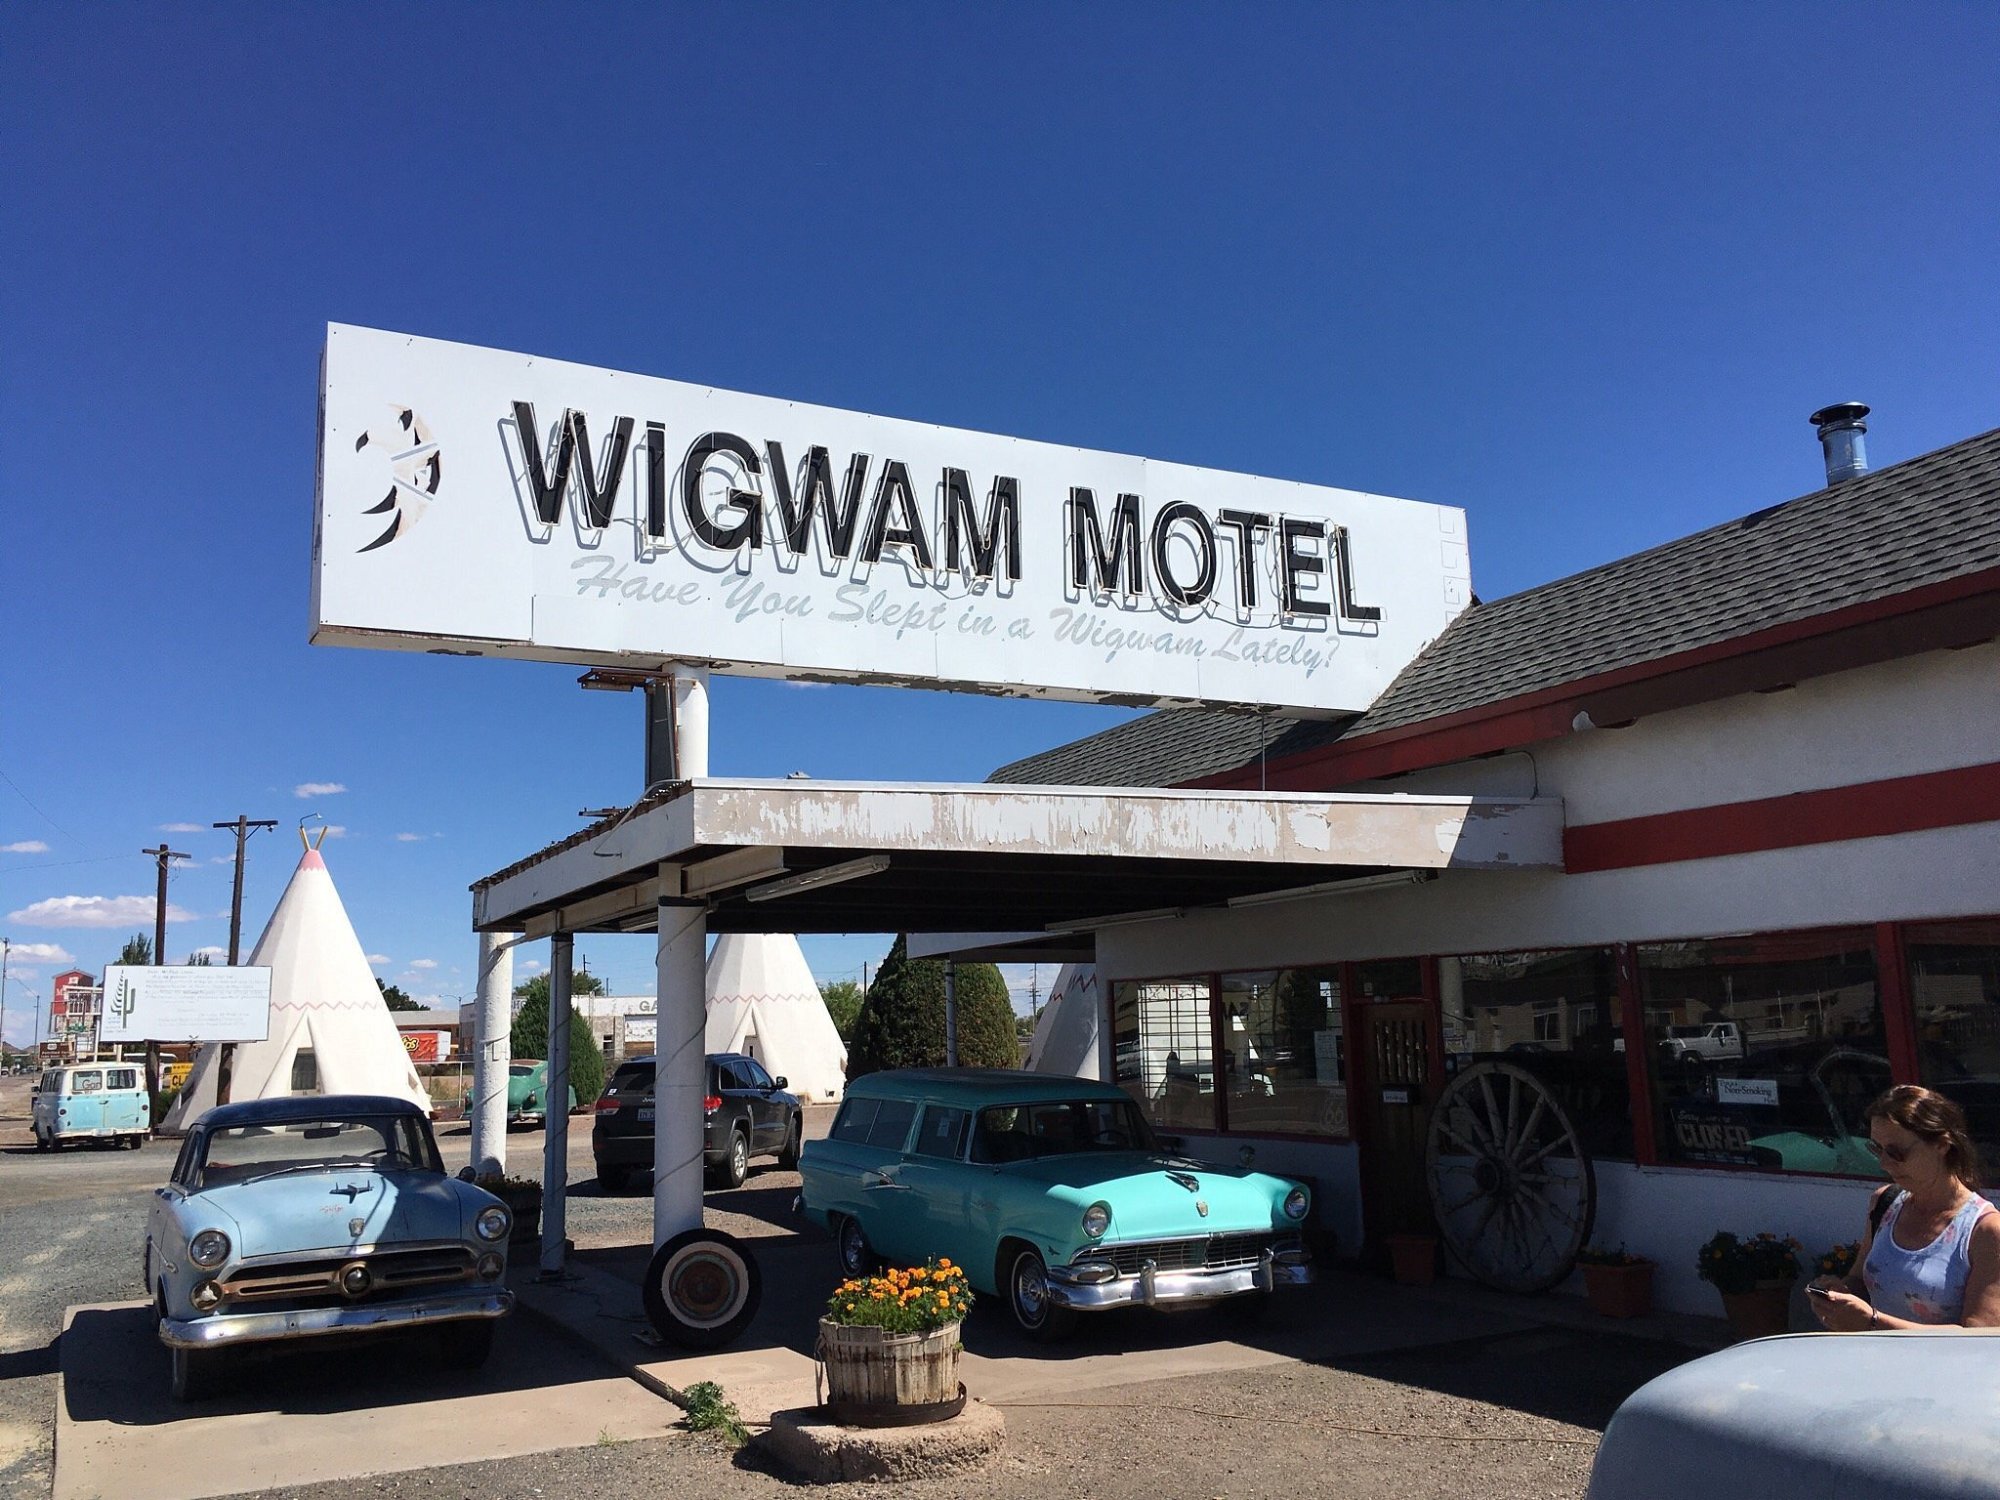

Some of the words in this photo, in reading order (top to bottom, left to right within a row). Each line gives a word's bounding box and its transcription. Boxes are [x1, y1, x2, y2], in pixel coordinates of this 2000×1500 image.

[511, 400, 1022, 581] WIGWAM
[1069, 486, 1386, 622] MOTEL
[570, 555, 701, 606] Have
[720, 571, 814, 623] You
[828, 583, 946, 640] Slept
[956, 604, 997, 634] in
[1008, 619, 1035, 640] a
[1049, 607, 1207, 664] Wigwam
[1206, 630, 1341, 678] Lately?
[1677, 1122, 1753, 1153] CLOSED
